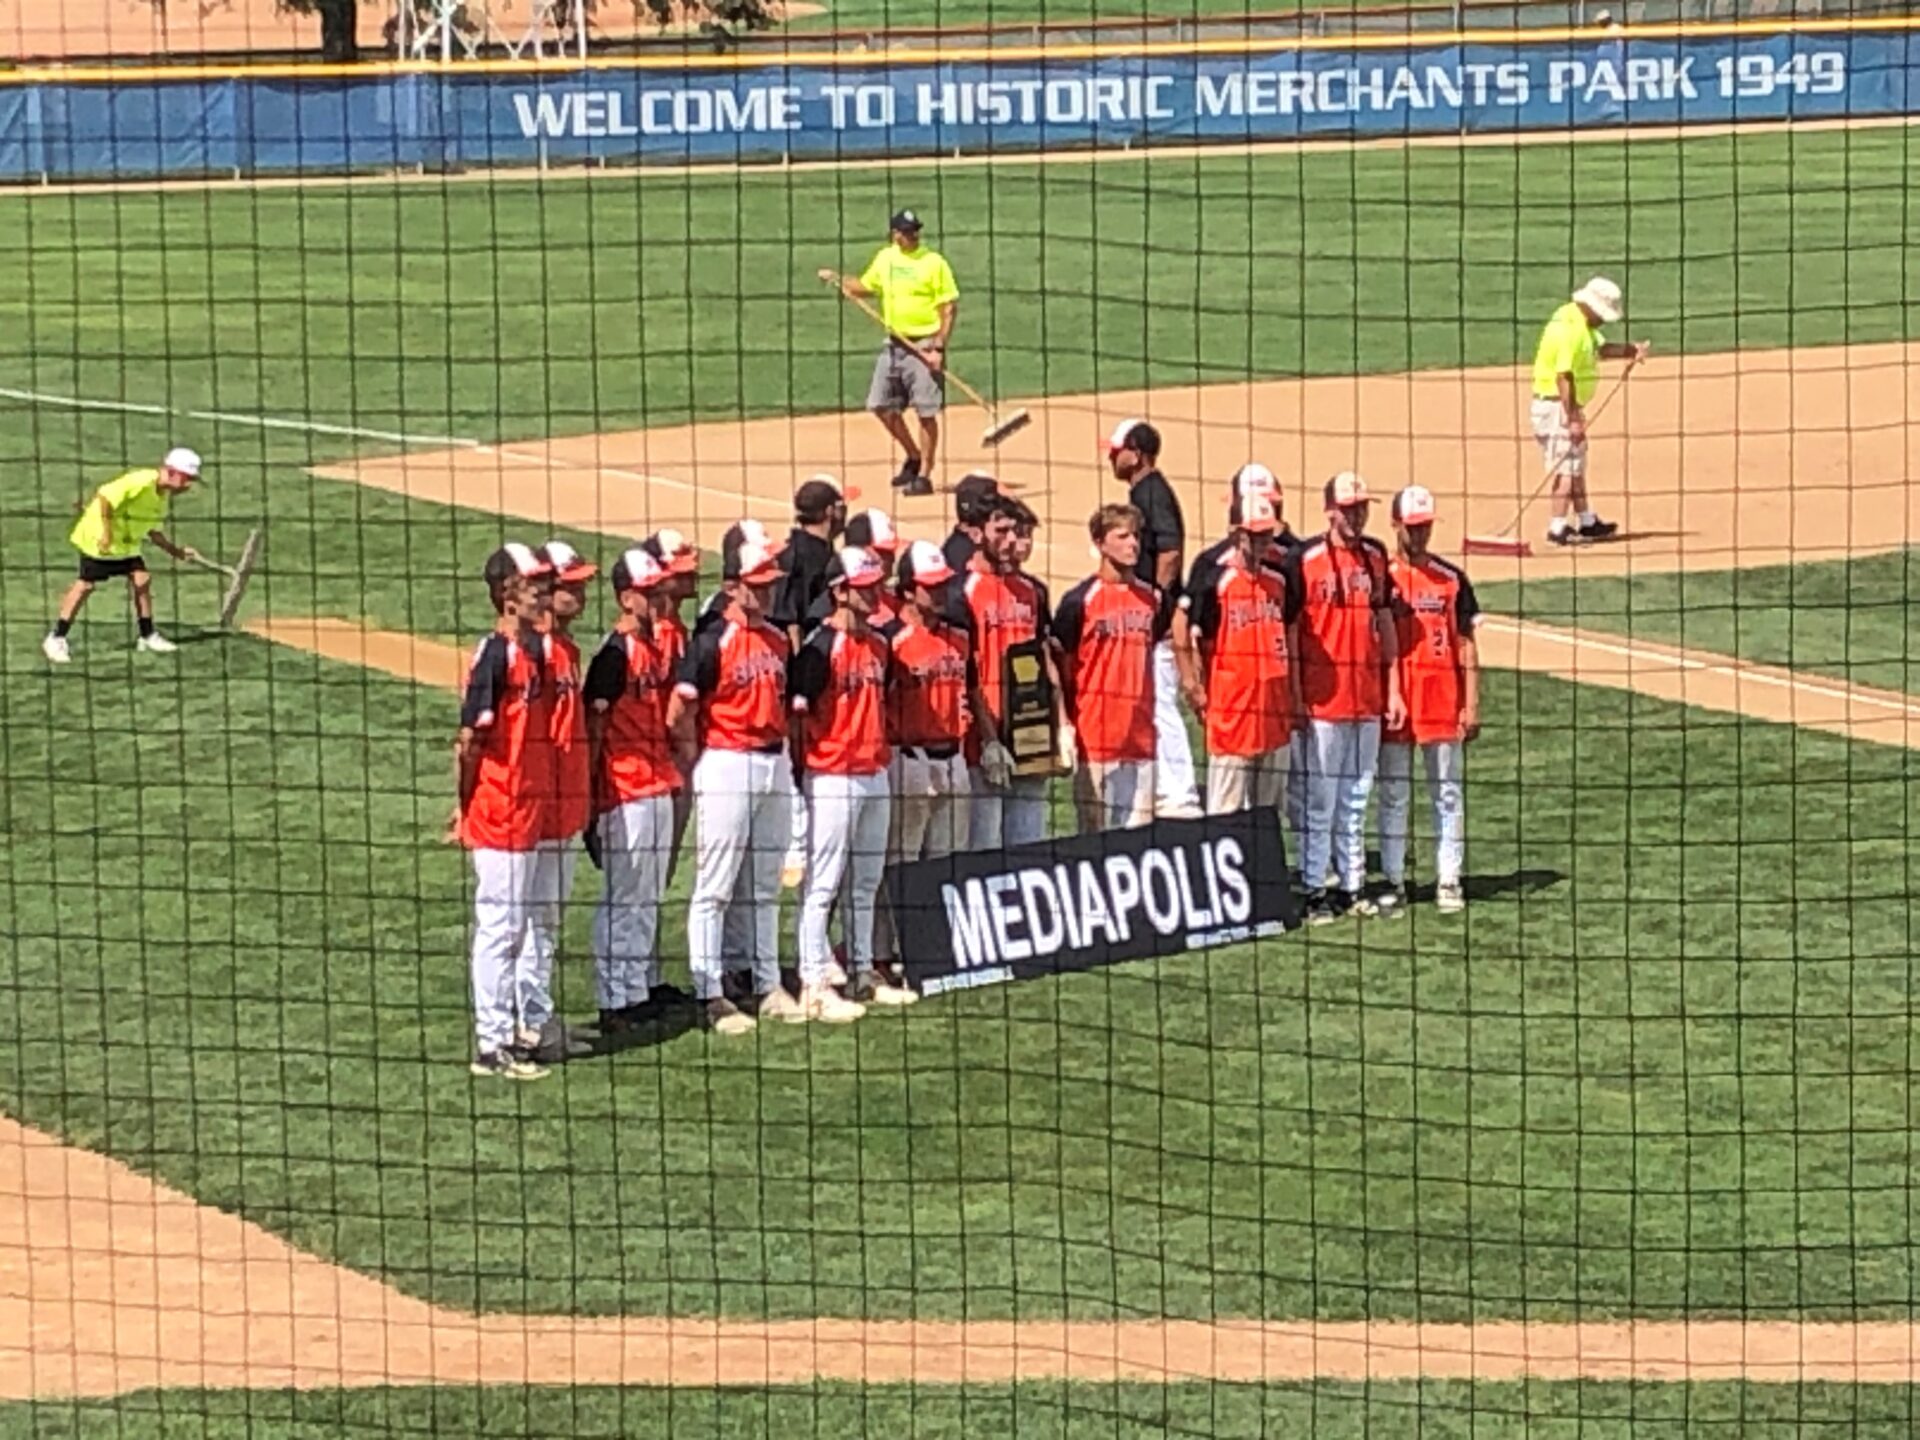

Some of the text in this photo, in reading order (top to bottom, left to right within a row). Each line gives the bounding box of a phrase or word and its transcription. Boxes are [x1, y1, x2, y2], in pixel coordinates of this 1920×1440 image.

[513, 52, 1845, 137] WELCOME TO HISTORIC MERCHANTS PARK 1949
[942, 837, 1251, 968] MEDIAPOLIS
